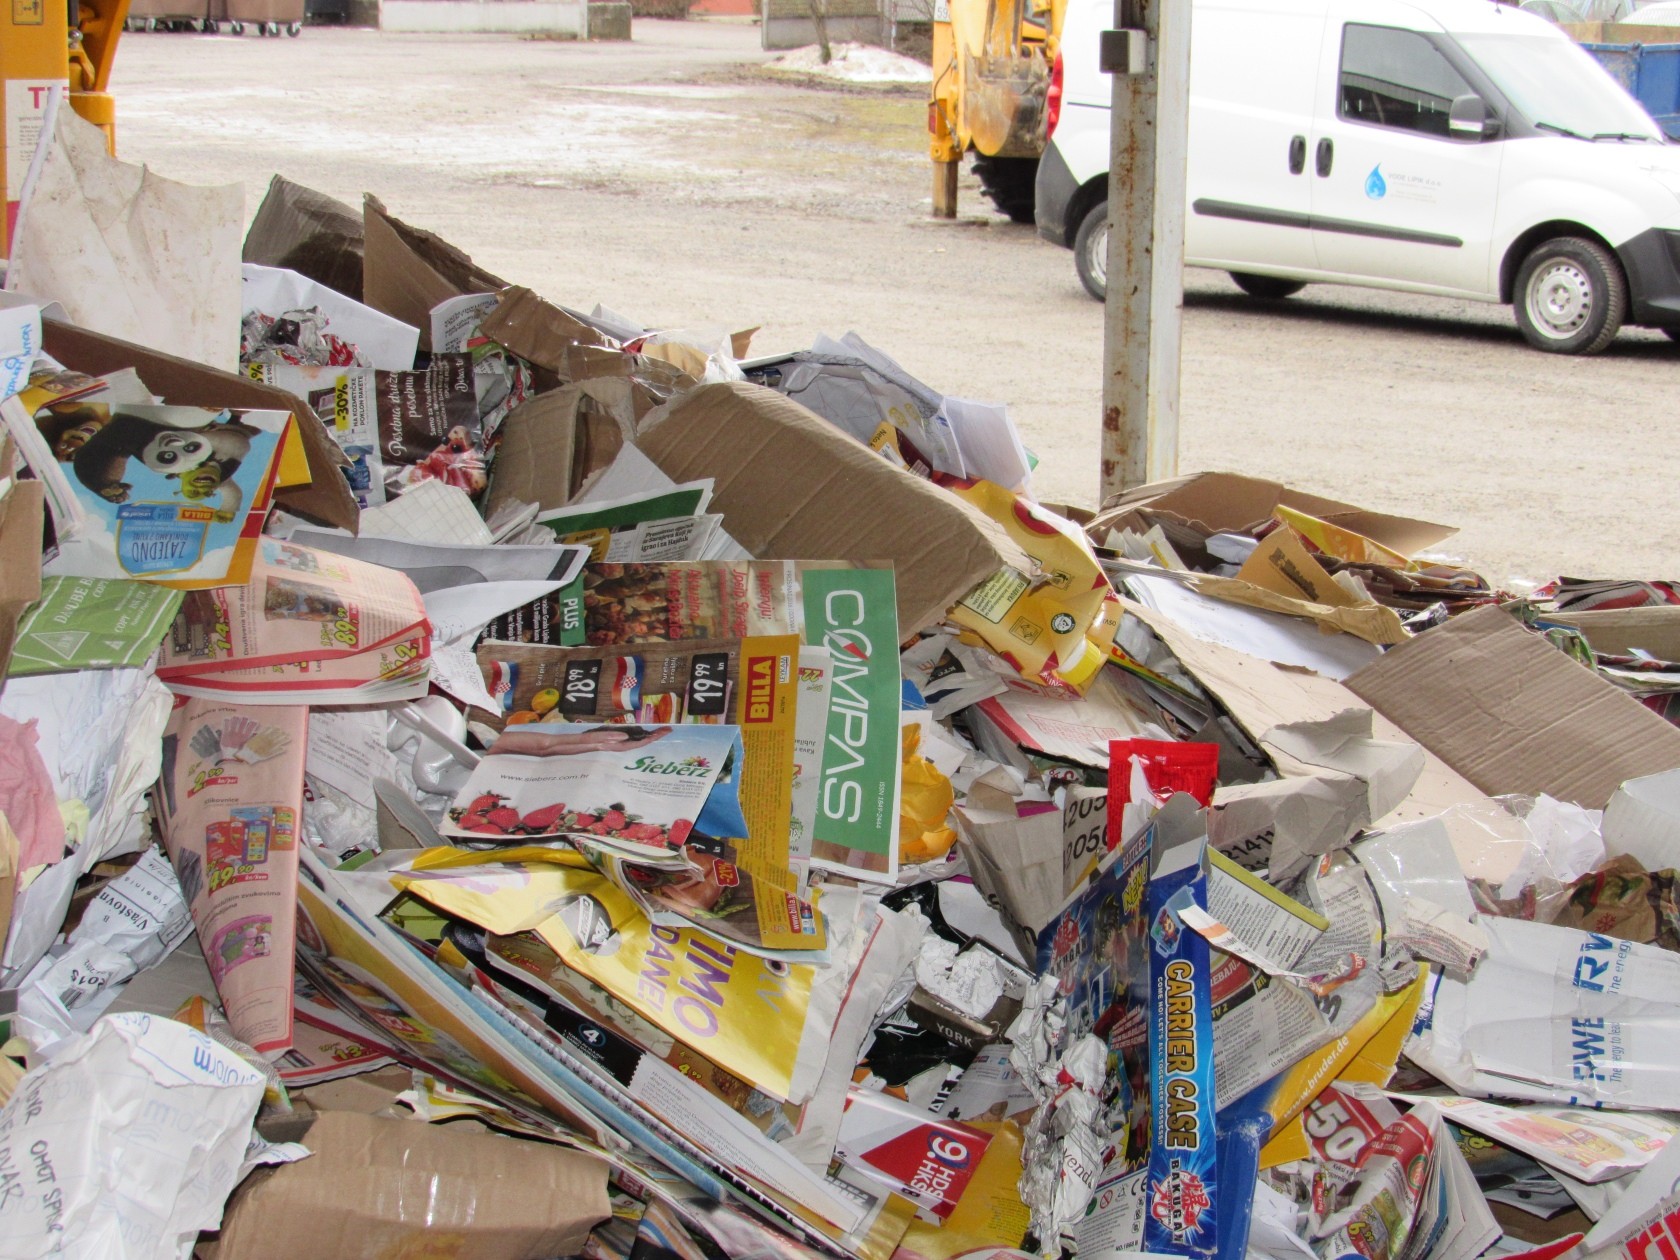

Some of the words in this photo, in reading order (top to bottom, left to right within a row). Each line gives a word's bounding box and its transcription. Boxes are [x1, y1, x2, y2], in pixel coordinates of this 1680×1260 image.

[336, 383, 349, 421] -30%
[131, 539, 187, 563] ZAJEDNO
[731, 569, 748, 598] Josip
[757, 570, 775, 620] Intervju:
[563, 597, 580, 630] PLUS
[750, 659, 771, 718] BILLA
[823, 589, 873, 823] COMPAS
[500, 773, 590, 782] www.sieberz.com.hr
[623, 755, 714, 778] Sieberz
[673, 938, 736, 1038] IMO
[1157, 976, 1165, 1000] COME
[1606, 975, 1622, 995] The
[935, 1022, 974, 1047] YORK
[1157, 1016, 1165, 1040] LET'S
[1164, 959, 1197, 1075] CARRIER
[583, 1028, 600, 1043] 4
[1157, 1042, 1165, 1057] ALL
[1157, 1059, 1165, 1101] TOGETHER
[1283, 1035, 1349, 1118] www.bruder.de
[1164, 1078, 1198, 1150] CASE
[1170, 1158, 1185, 1243] BAKUGAN
